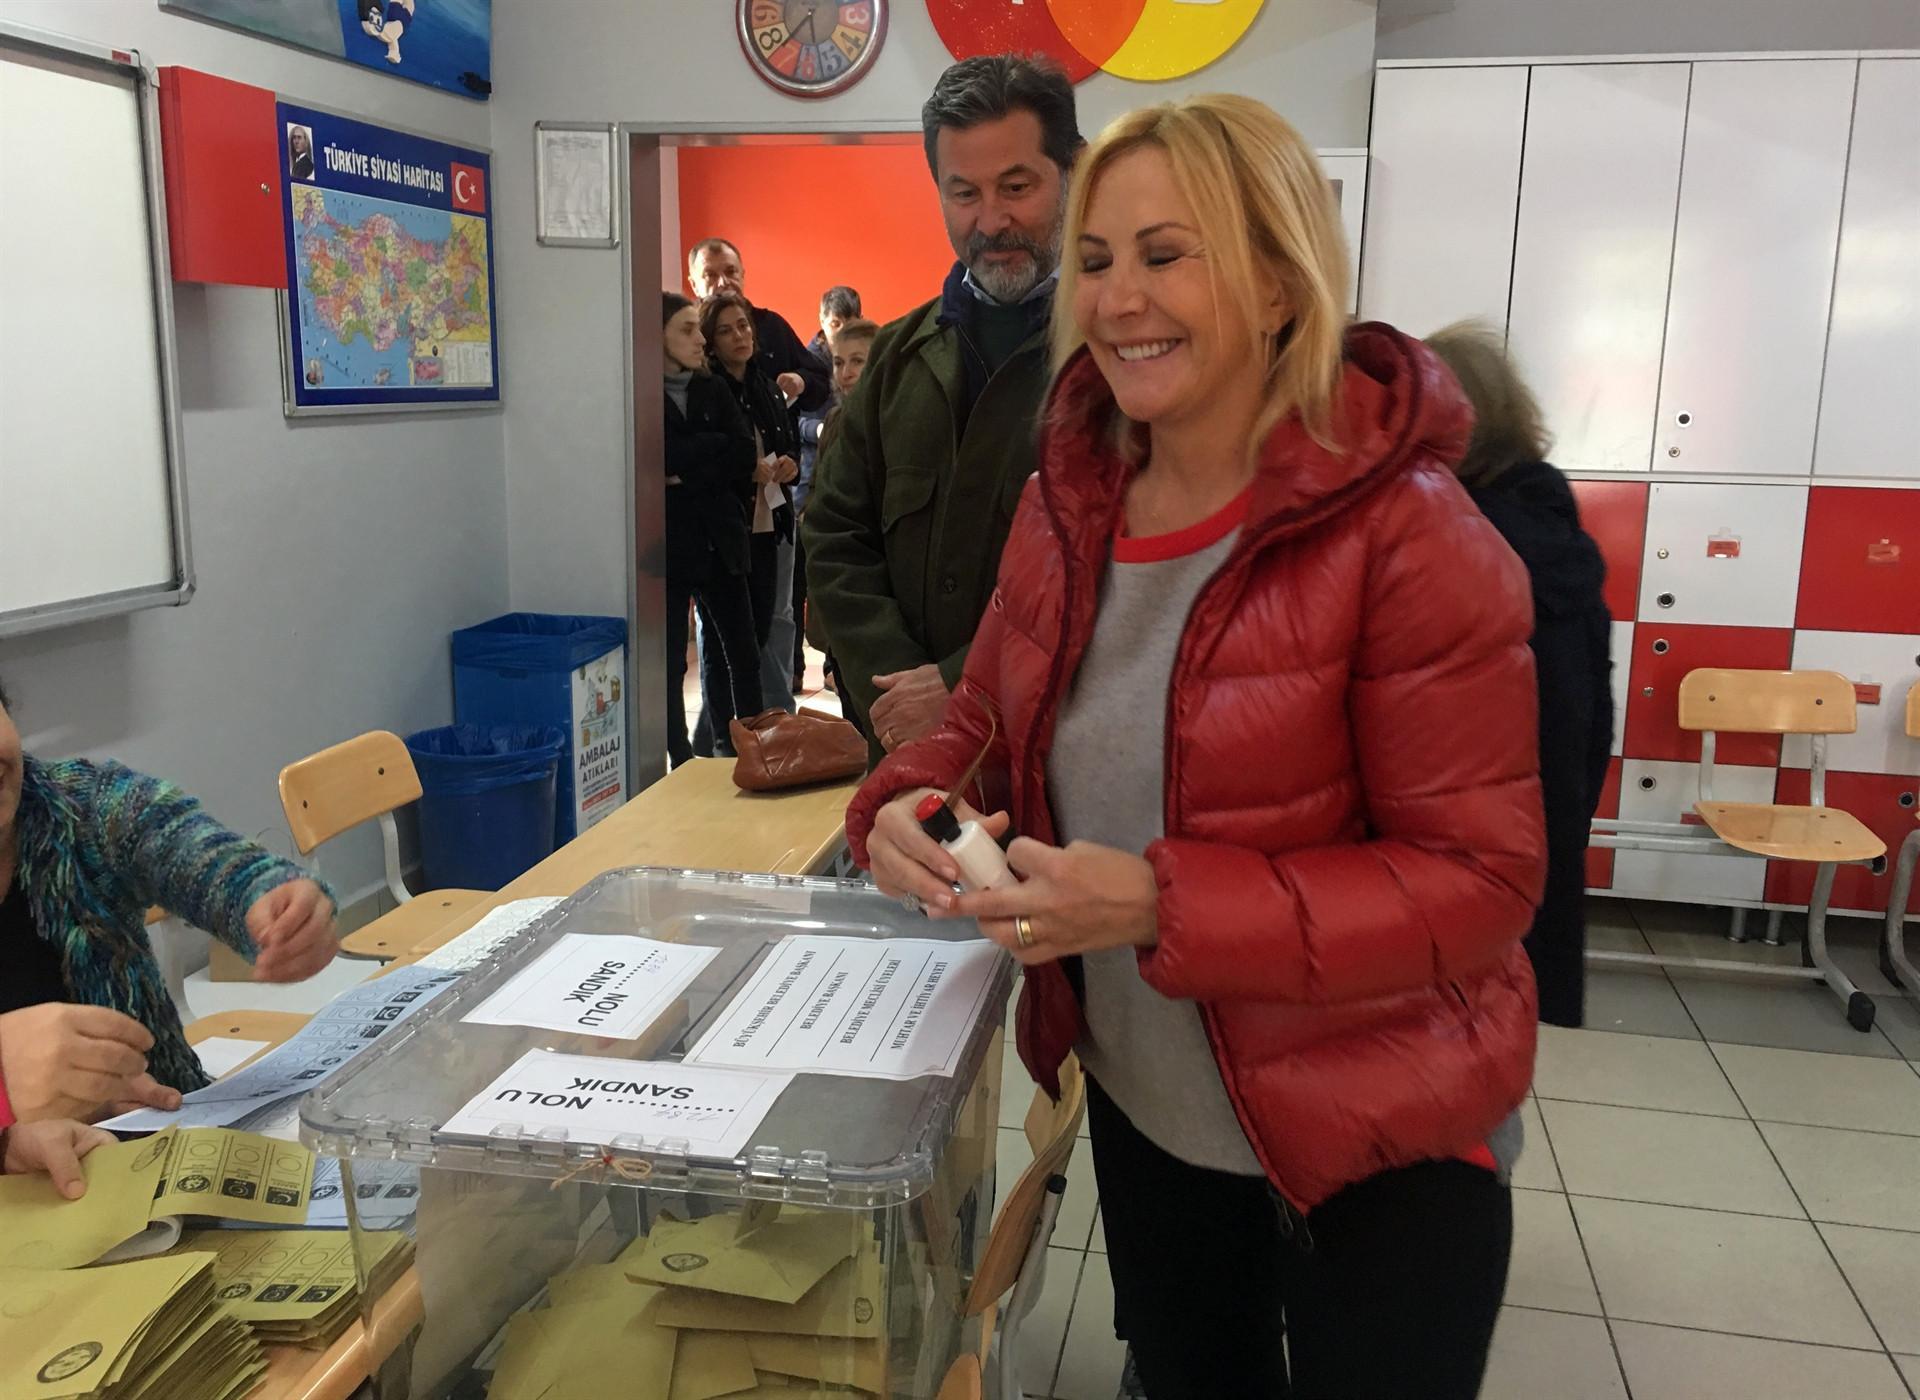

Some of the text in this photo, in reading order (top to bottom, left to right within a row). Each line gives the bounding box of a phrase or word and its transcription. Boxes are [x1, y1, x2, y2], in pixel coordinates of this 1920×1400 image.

[759, 27, 783, 51] 8
[323, 142, 444, 193] TÜRKİYE SİYASİ HARİTASI
[579, 735, 620, 770] AMBALAJ
[582, 755, 618, 784] ATIKLARI
[563, 960, 626, 1003] SANDIK
[733, 950, 817, 1048] BÜYÜKŞEHİR BELEDİYE BAŞKANI
[800, 971, 849, 1030] BELEDİYE BAŞKANI
[577, 992, 629, 1026] NOLU
[840, 959, 902, 1044] BELEDİYE MECLİSİ ÜYELERİ
[890, 961, 949, 1050] MUHTAR VE İHTİYAR HEYETİ
[495, 1089, 593, 1110] NOLU
[565, 1077, 695, 1100] SANDIK
